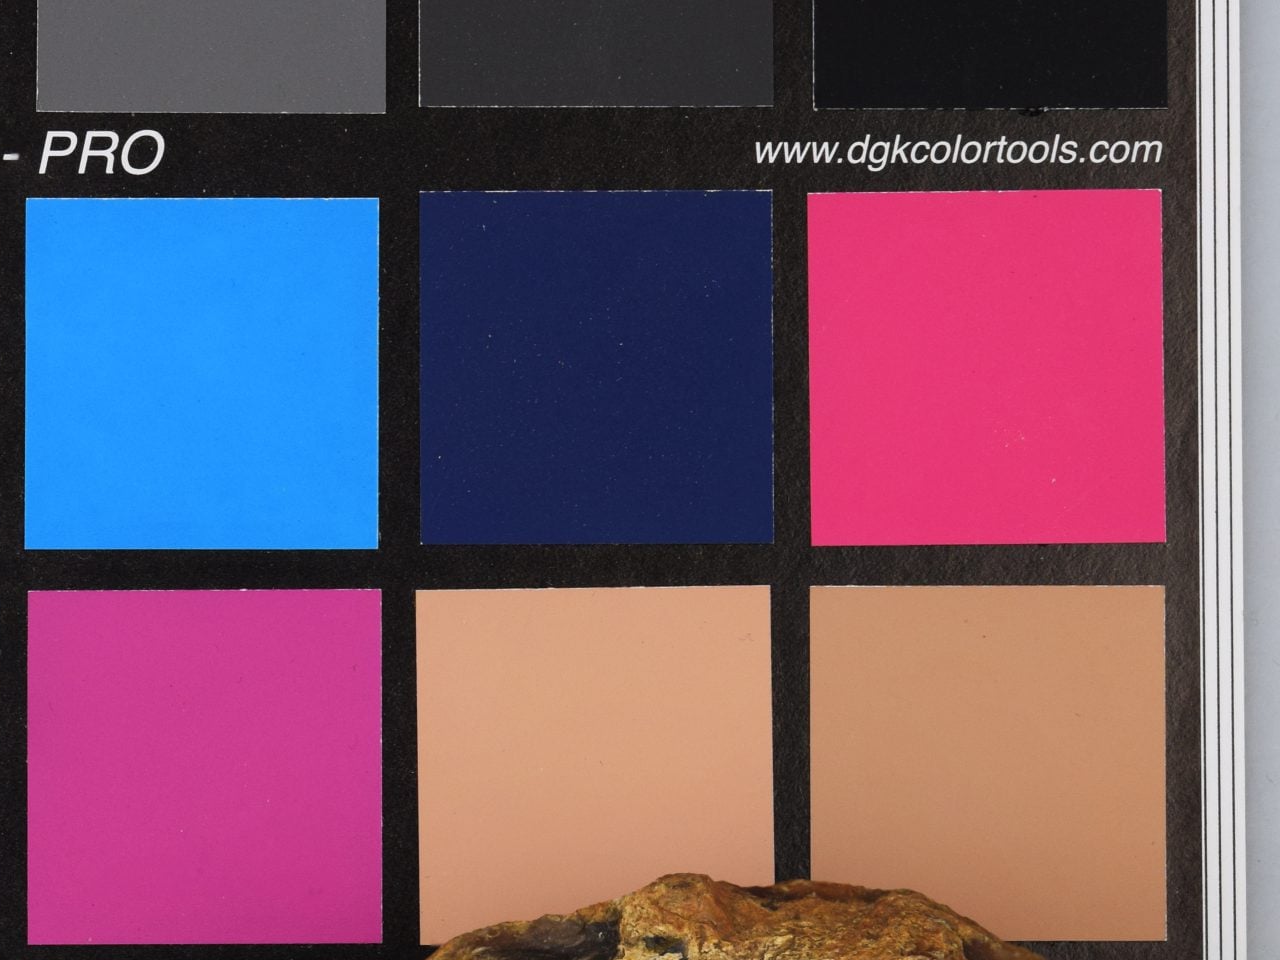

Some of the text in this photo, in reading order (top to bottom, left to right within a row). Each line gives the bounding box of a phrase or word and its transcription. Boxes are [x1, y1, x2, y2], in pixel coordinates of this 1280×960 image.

[2, 153, 20, 161] -
[38, 129, 166, 176] PRO
[755, 133, 1163, 172] www.dgkcolortools.com
